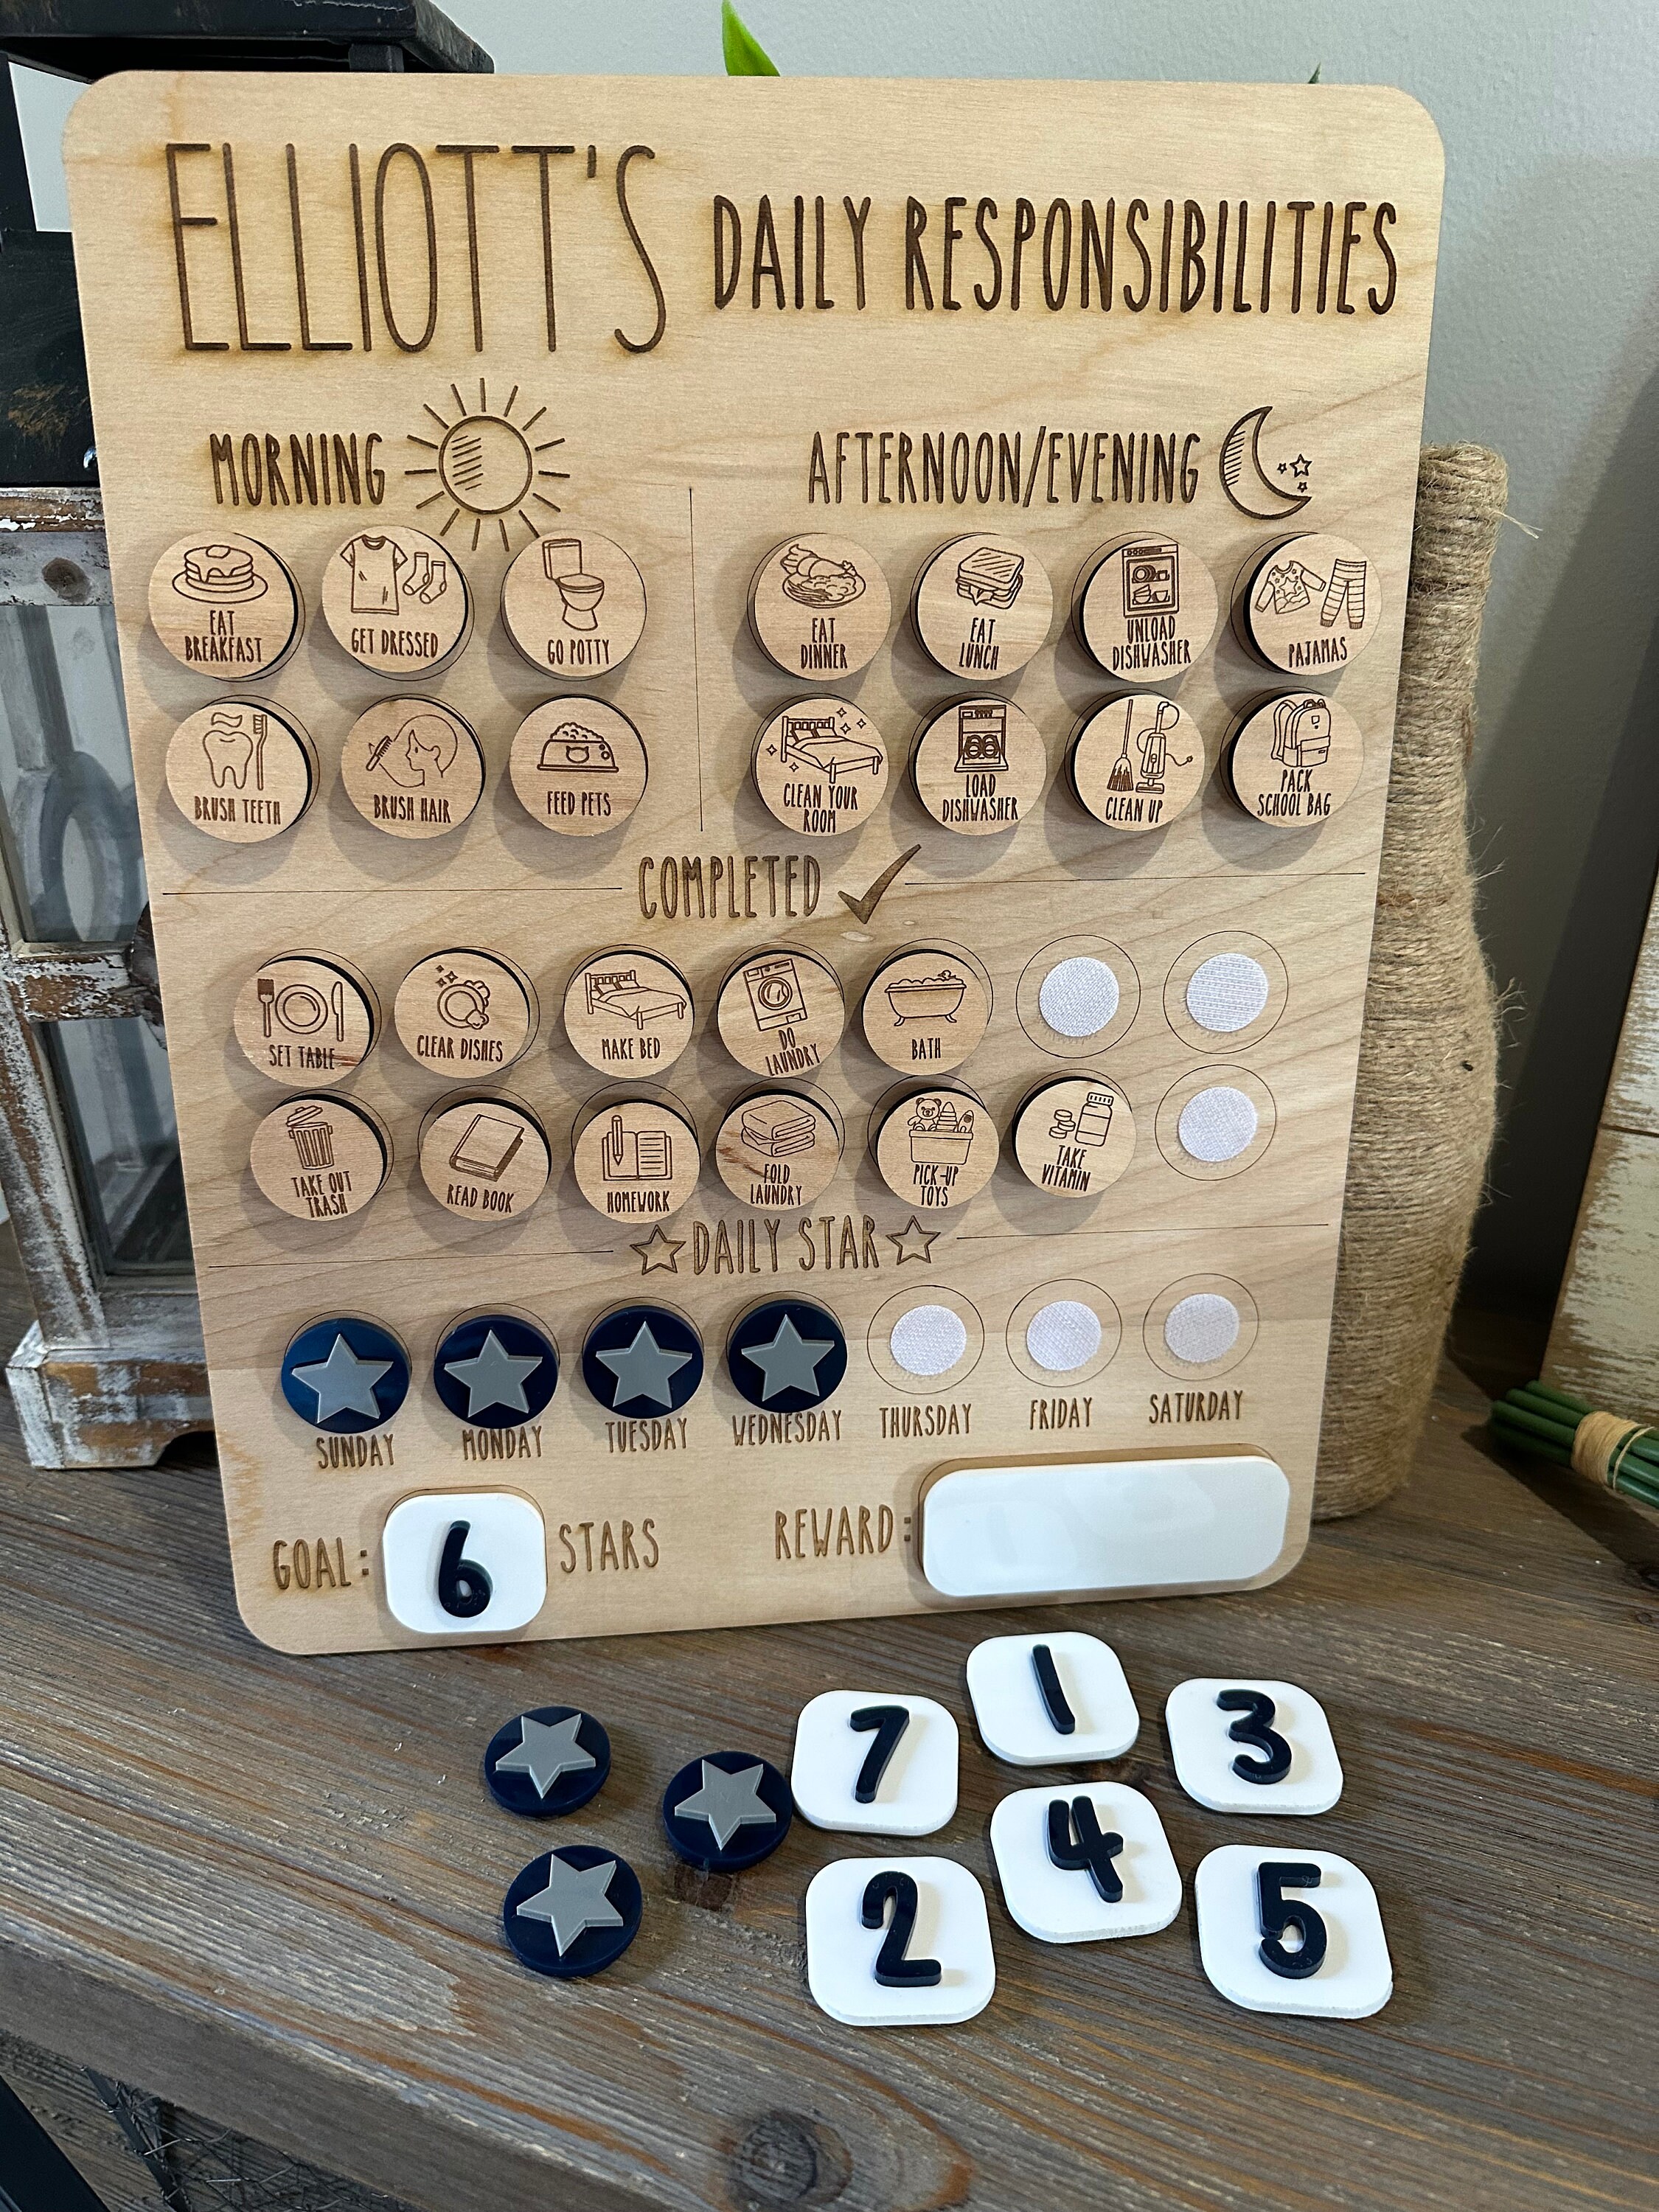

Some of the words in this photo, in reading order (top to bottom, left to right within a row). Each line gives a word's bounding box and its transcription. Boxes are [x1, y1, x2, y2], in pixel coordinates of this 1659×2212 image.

[166, 143, 666, 352] ELLIOTT'S
[713, 195, 872, 311] DAILY
[905, 196, 1397, 315] RESPONSIBILITIES
[209, 433, 385, 507] MORNING
[808, 426, 1200, 507] AFTERNOON/EVENING
[209, 611, 235, 636] EAT
[812, 618, 835, 642] EAT
[970, 618, 995, 643] EAT
[1127, 616, 1176, 642] UNLOAD
[185, 636, 262, 663] BREAKFAST
[351, 629, 375, 655] GET
[381, 630, 438, 658] DRESSED
[547, 639, 565, 664] GO
[569, 639, 610, 664] POTTY
[801, 644, 847, 669] DINNER
[959, 643, 999, 670] LUNCH
[1113, 639, 1191, 670] DISHWASHER
[1288, 637, 1347, 668] PAJAMAS
[965, 773, 996, 798] LOAD
[1281, 768, 1313, 792] PACK
[195, 796, 235, 822] BRUSH
[242, 799, 281, 825] TEETH
[374, 795, 414, 821] BRUSH
[420, 797, 451, 824] HAIR
[547, 791, 575, 815] FEED
[581, 792, 611, 816] PETS
[783, 783, 821, 808] CLEAN
[828, 785, 858, 810] YOUR
[942, 797, 1018, 822] DISHWASHER
[1106, 797, 1143, 822] CLEAN
[1148, 799, 1164, 823] UP
[1256, 793, 1303, 817] SCHOOL
[1307, 793, 1332, 816] BAG
[803, 809, 836, 833] ROOM
[639, 855, 821, 919] COMPLETED
[417, 1034, 454, 1059] CLEAR
[460, 1037, 504, 1062] DISHES
[602, 1038, 634, 1060] MAKE
[639, 1038, 661, 1060] BED
[779, 1027, 796, 1051] DO
[911, 1038, 941, 1060] BATH
[269, 1045, 291, 1067] SET
[299, 1046, 335, 1070] TABLE
[765, 1043, 821, 1077] LAUNDRY
[1056, 1145, 1088, 1171] TAKE
[291, 1176, 324, 1198] TAKE
[329, 1170, 352, 1193] OUT
[764, 1164, 790, 1183] FOLD
[1041, 1164, 1091, 1192] VITAMIN
[305, 1194, 348, 1218] TRASH
[446, 1183, 477, 1208] READ
[482, 1189, 515, 1214] BOOK
[607, 1191, 669, 1213] HOMEWORK
[750, 1183, 801, 1206] LAUNDRY
[920, 1186, 948, 1208] TOYS
[692, 1218, 780, 1275] DAILY
[798, 1214, 879, 1270] STAR
[879, 1402, 972, 1439] THURSDAY
[1029, 1397, 1093, 1430] FRIDAY
[1148, 1390, 1244, 1424] SATURDAY
[605, 1418, 688, 1453] TUESDAY
[732, 1409, 844, 1446] WEDNESDAY
[316, 1434, 395, 1470] SUNDAY
[462, 1425, 542, 1461] MONDAY
[775, 1504, 911, 1559] REWARD:
[273, 1537, 369, 1590] GOAL:
[438, 1520, 493, 1618] 6
[559, 1517, 659, 1573] STARS
[1216, 1688, 1293, 1785] 3
[850, 1705, 910, 1804] 7
[1047, 1795, 1124, 1902] 4
[861, 1871, 942, 1988] 2
[1256, 1862, 1328, 1979] 5
